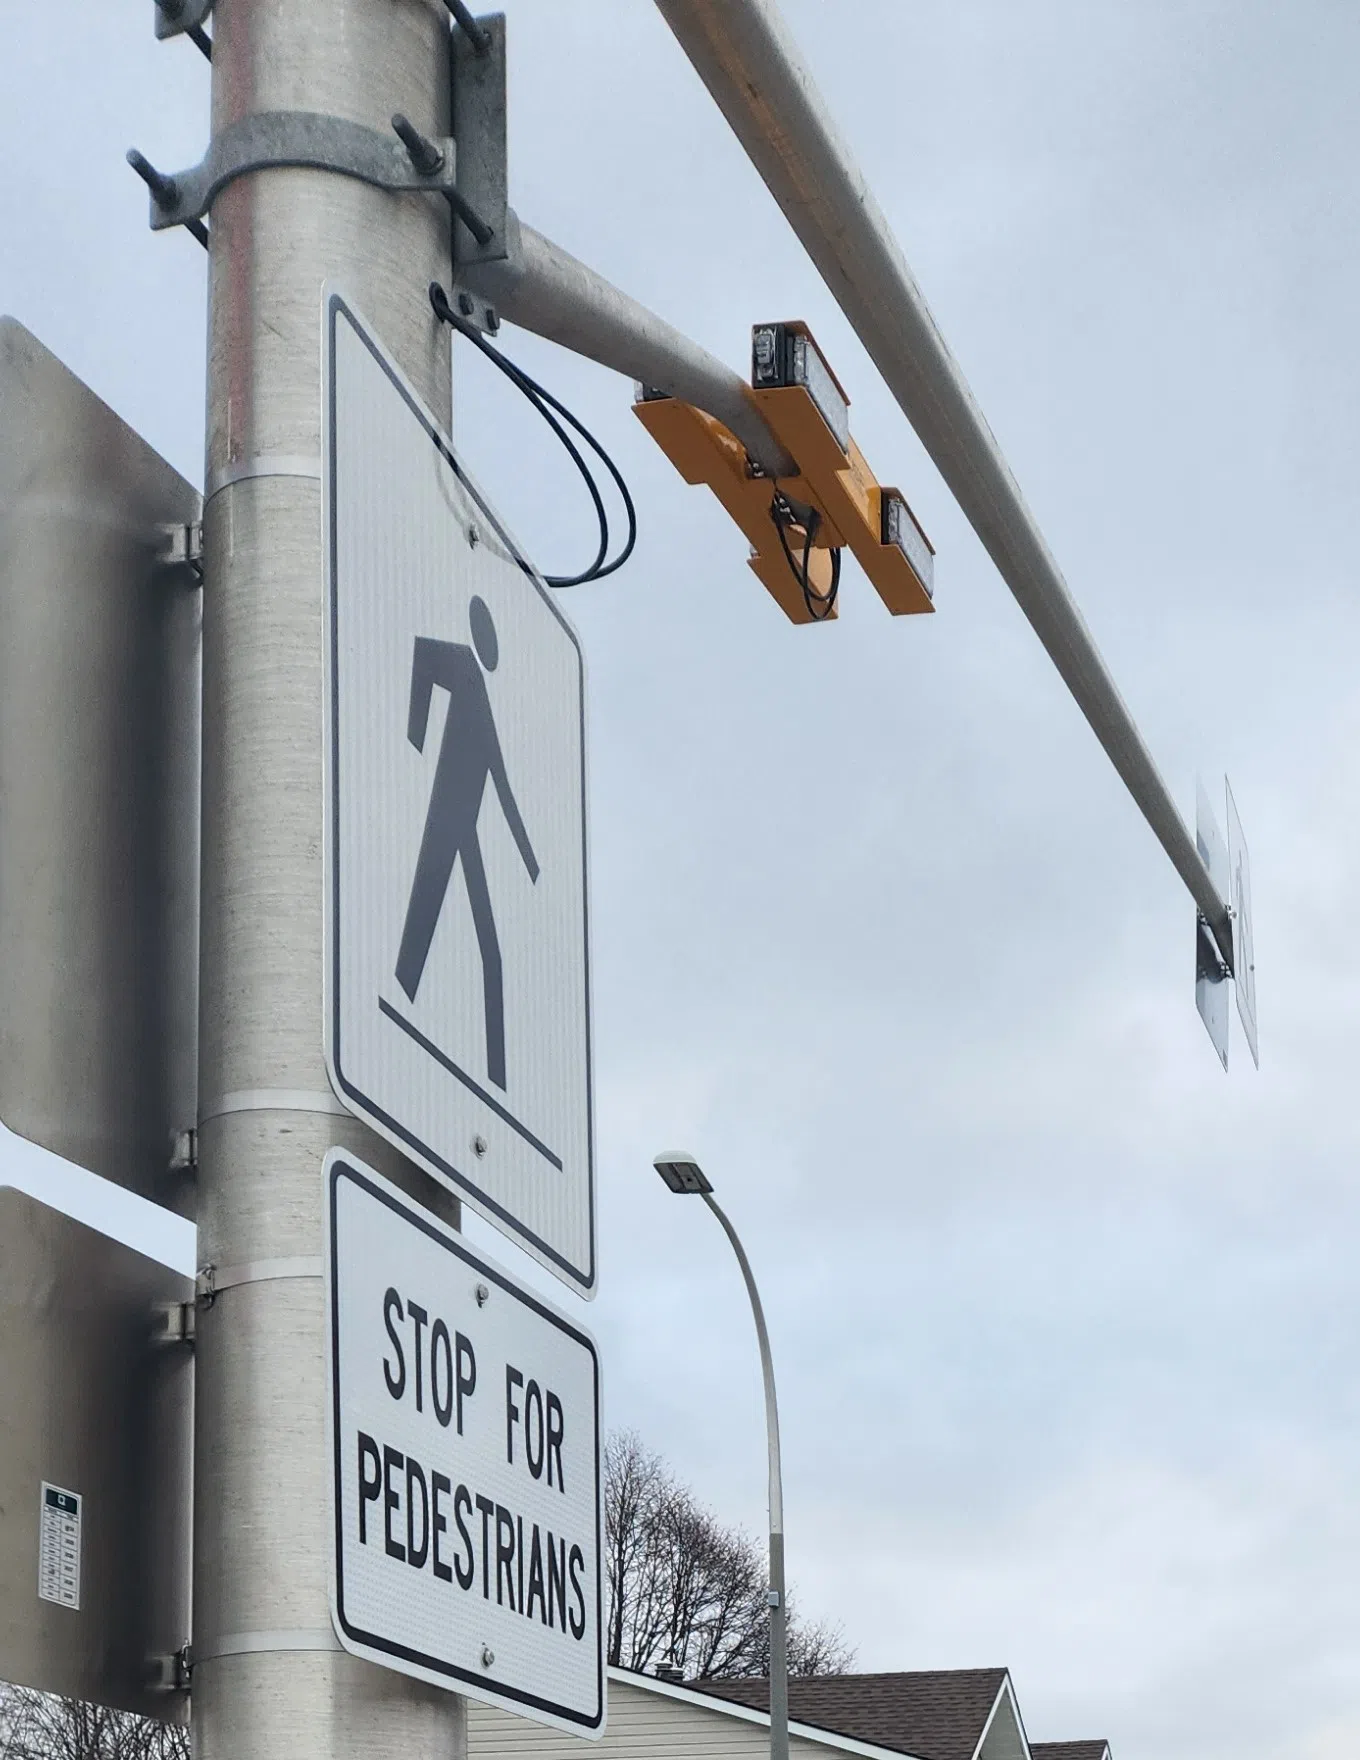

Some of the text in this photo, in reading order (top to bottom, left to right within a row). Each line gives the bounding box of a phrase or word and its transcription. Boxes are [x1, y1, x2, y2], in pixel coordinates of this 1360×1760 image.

[383, 1286, 564, 1494] STOP FOR
[357, 1430, 586, 1641] PEDESTRIANS
